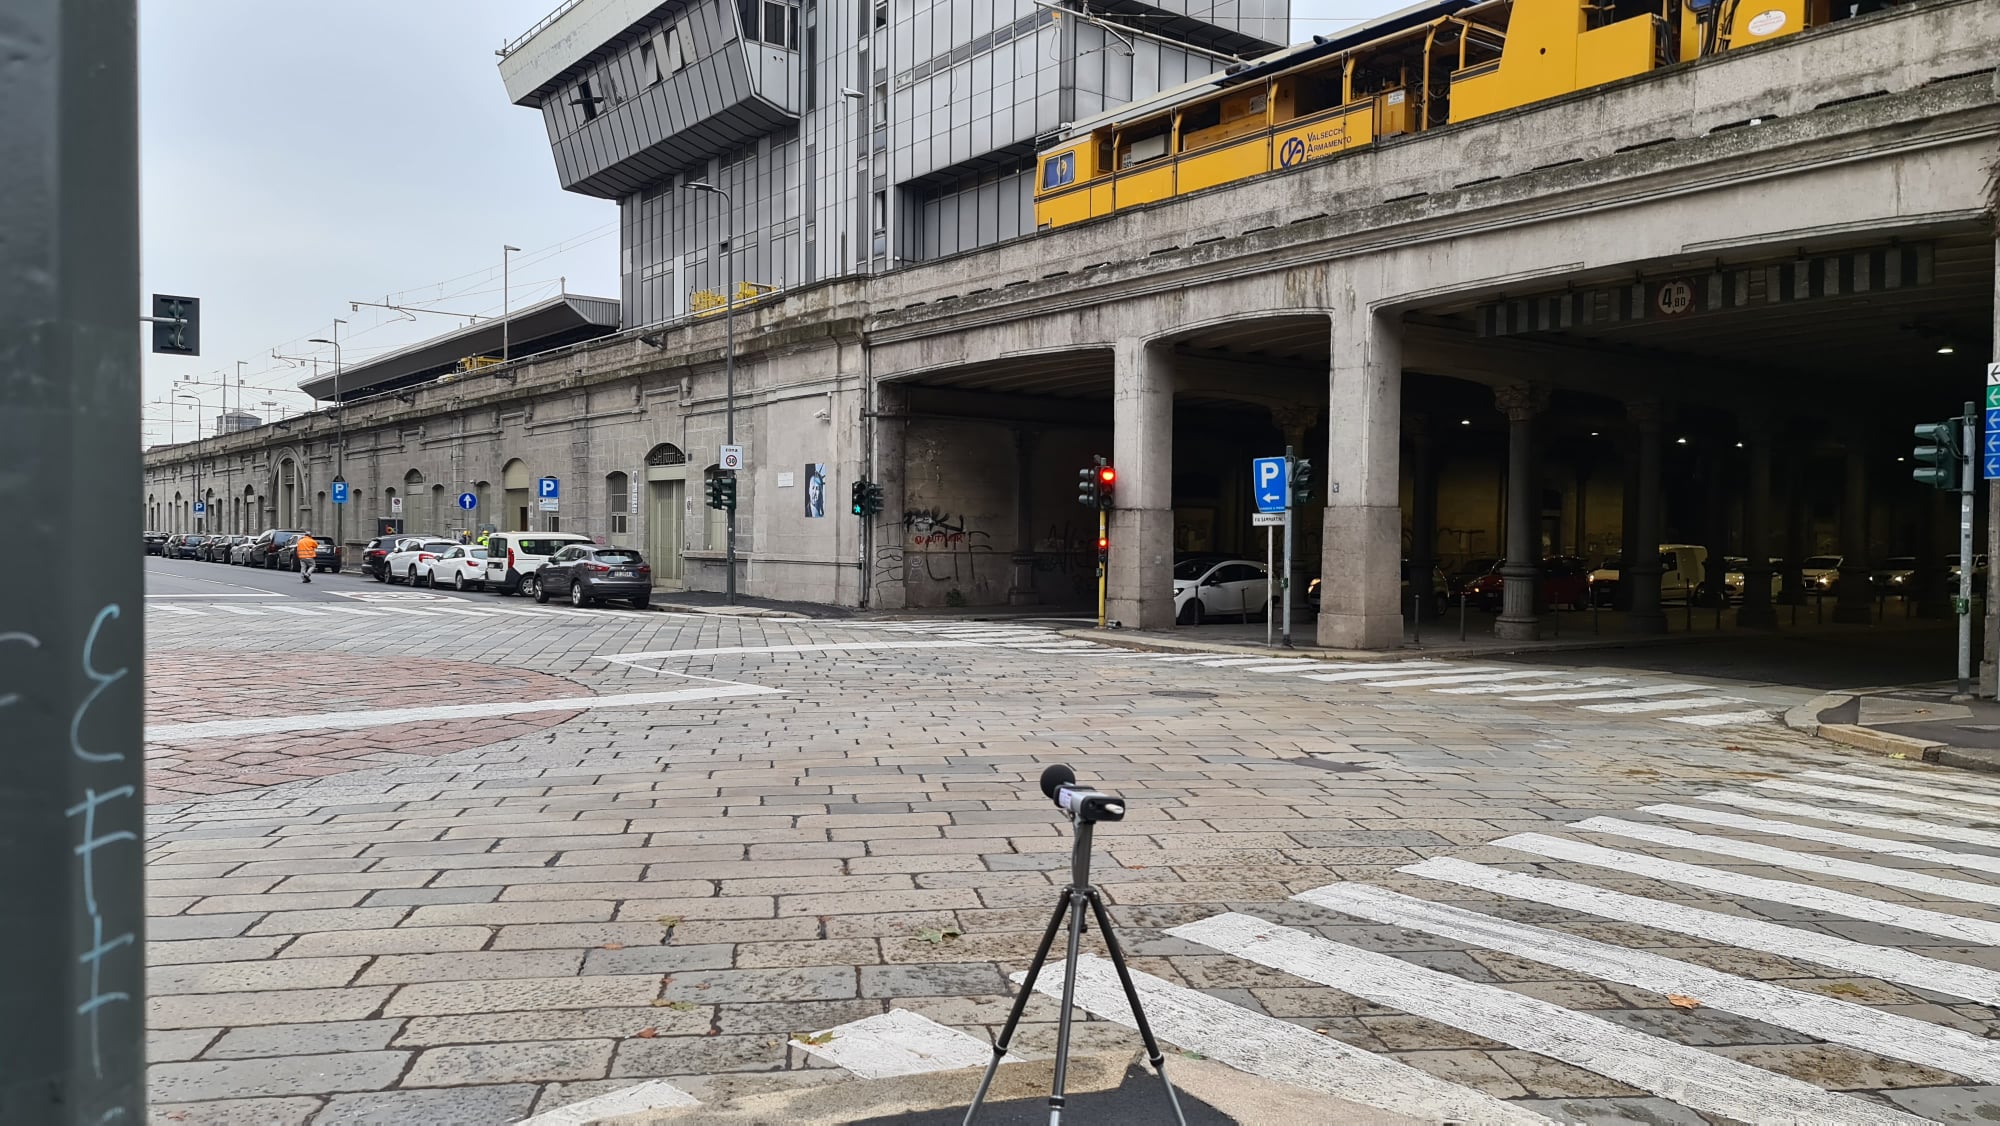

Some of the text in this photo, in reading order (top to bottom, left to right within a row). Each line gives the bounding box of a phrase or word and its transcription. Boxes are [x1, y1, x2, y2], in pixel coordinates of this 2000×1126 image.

[1306, 136, 1352, 153] ARMAMENTO
[1261, 462, 1279, 488] P
[335, 483, 344, 494] P
[542, 479, 555, 496] P
[195, 502, 203, 511] P
